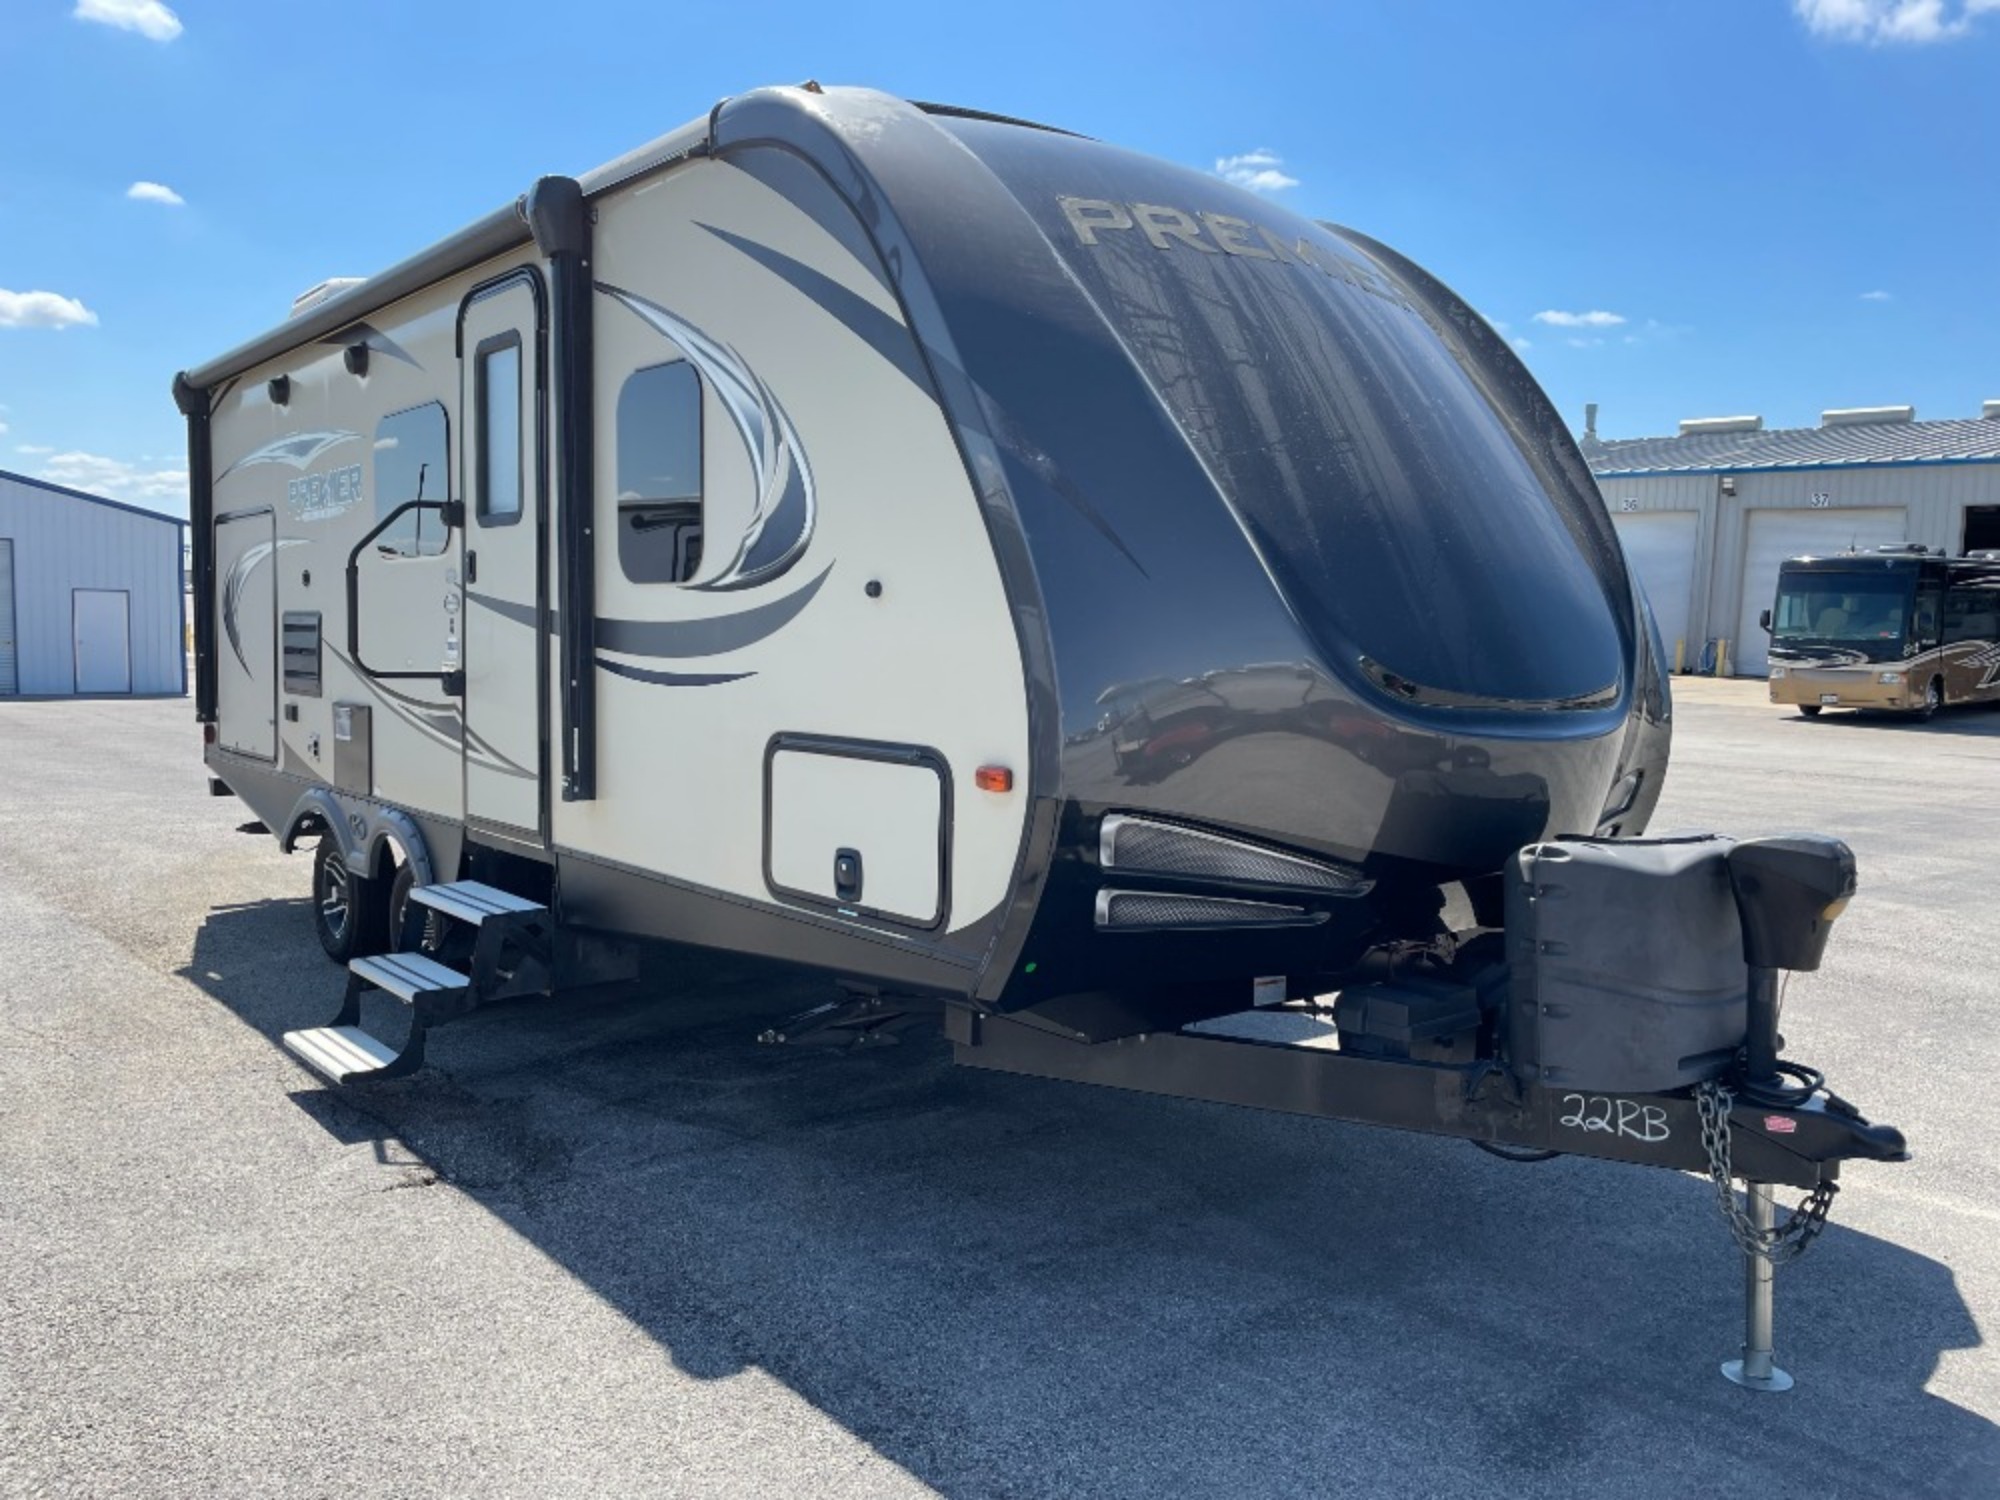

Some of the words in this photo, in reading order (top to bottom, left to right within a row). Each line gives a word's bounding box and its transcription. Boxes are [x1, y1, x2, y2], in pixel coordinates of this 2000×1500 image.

[1623, 499, 1637, 511] 36
[1811, 493, 1829, 507] 37
[1559, 1093, 1671, 1142] 22RB
